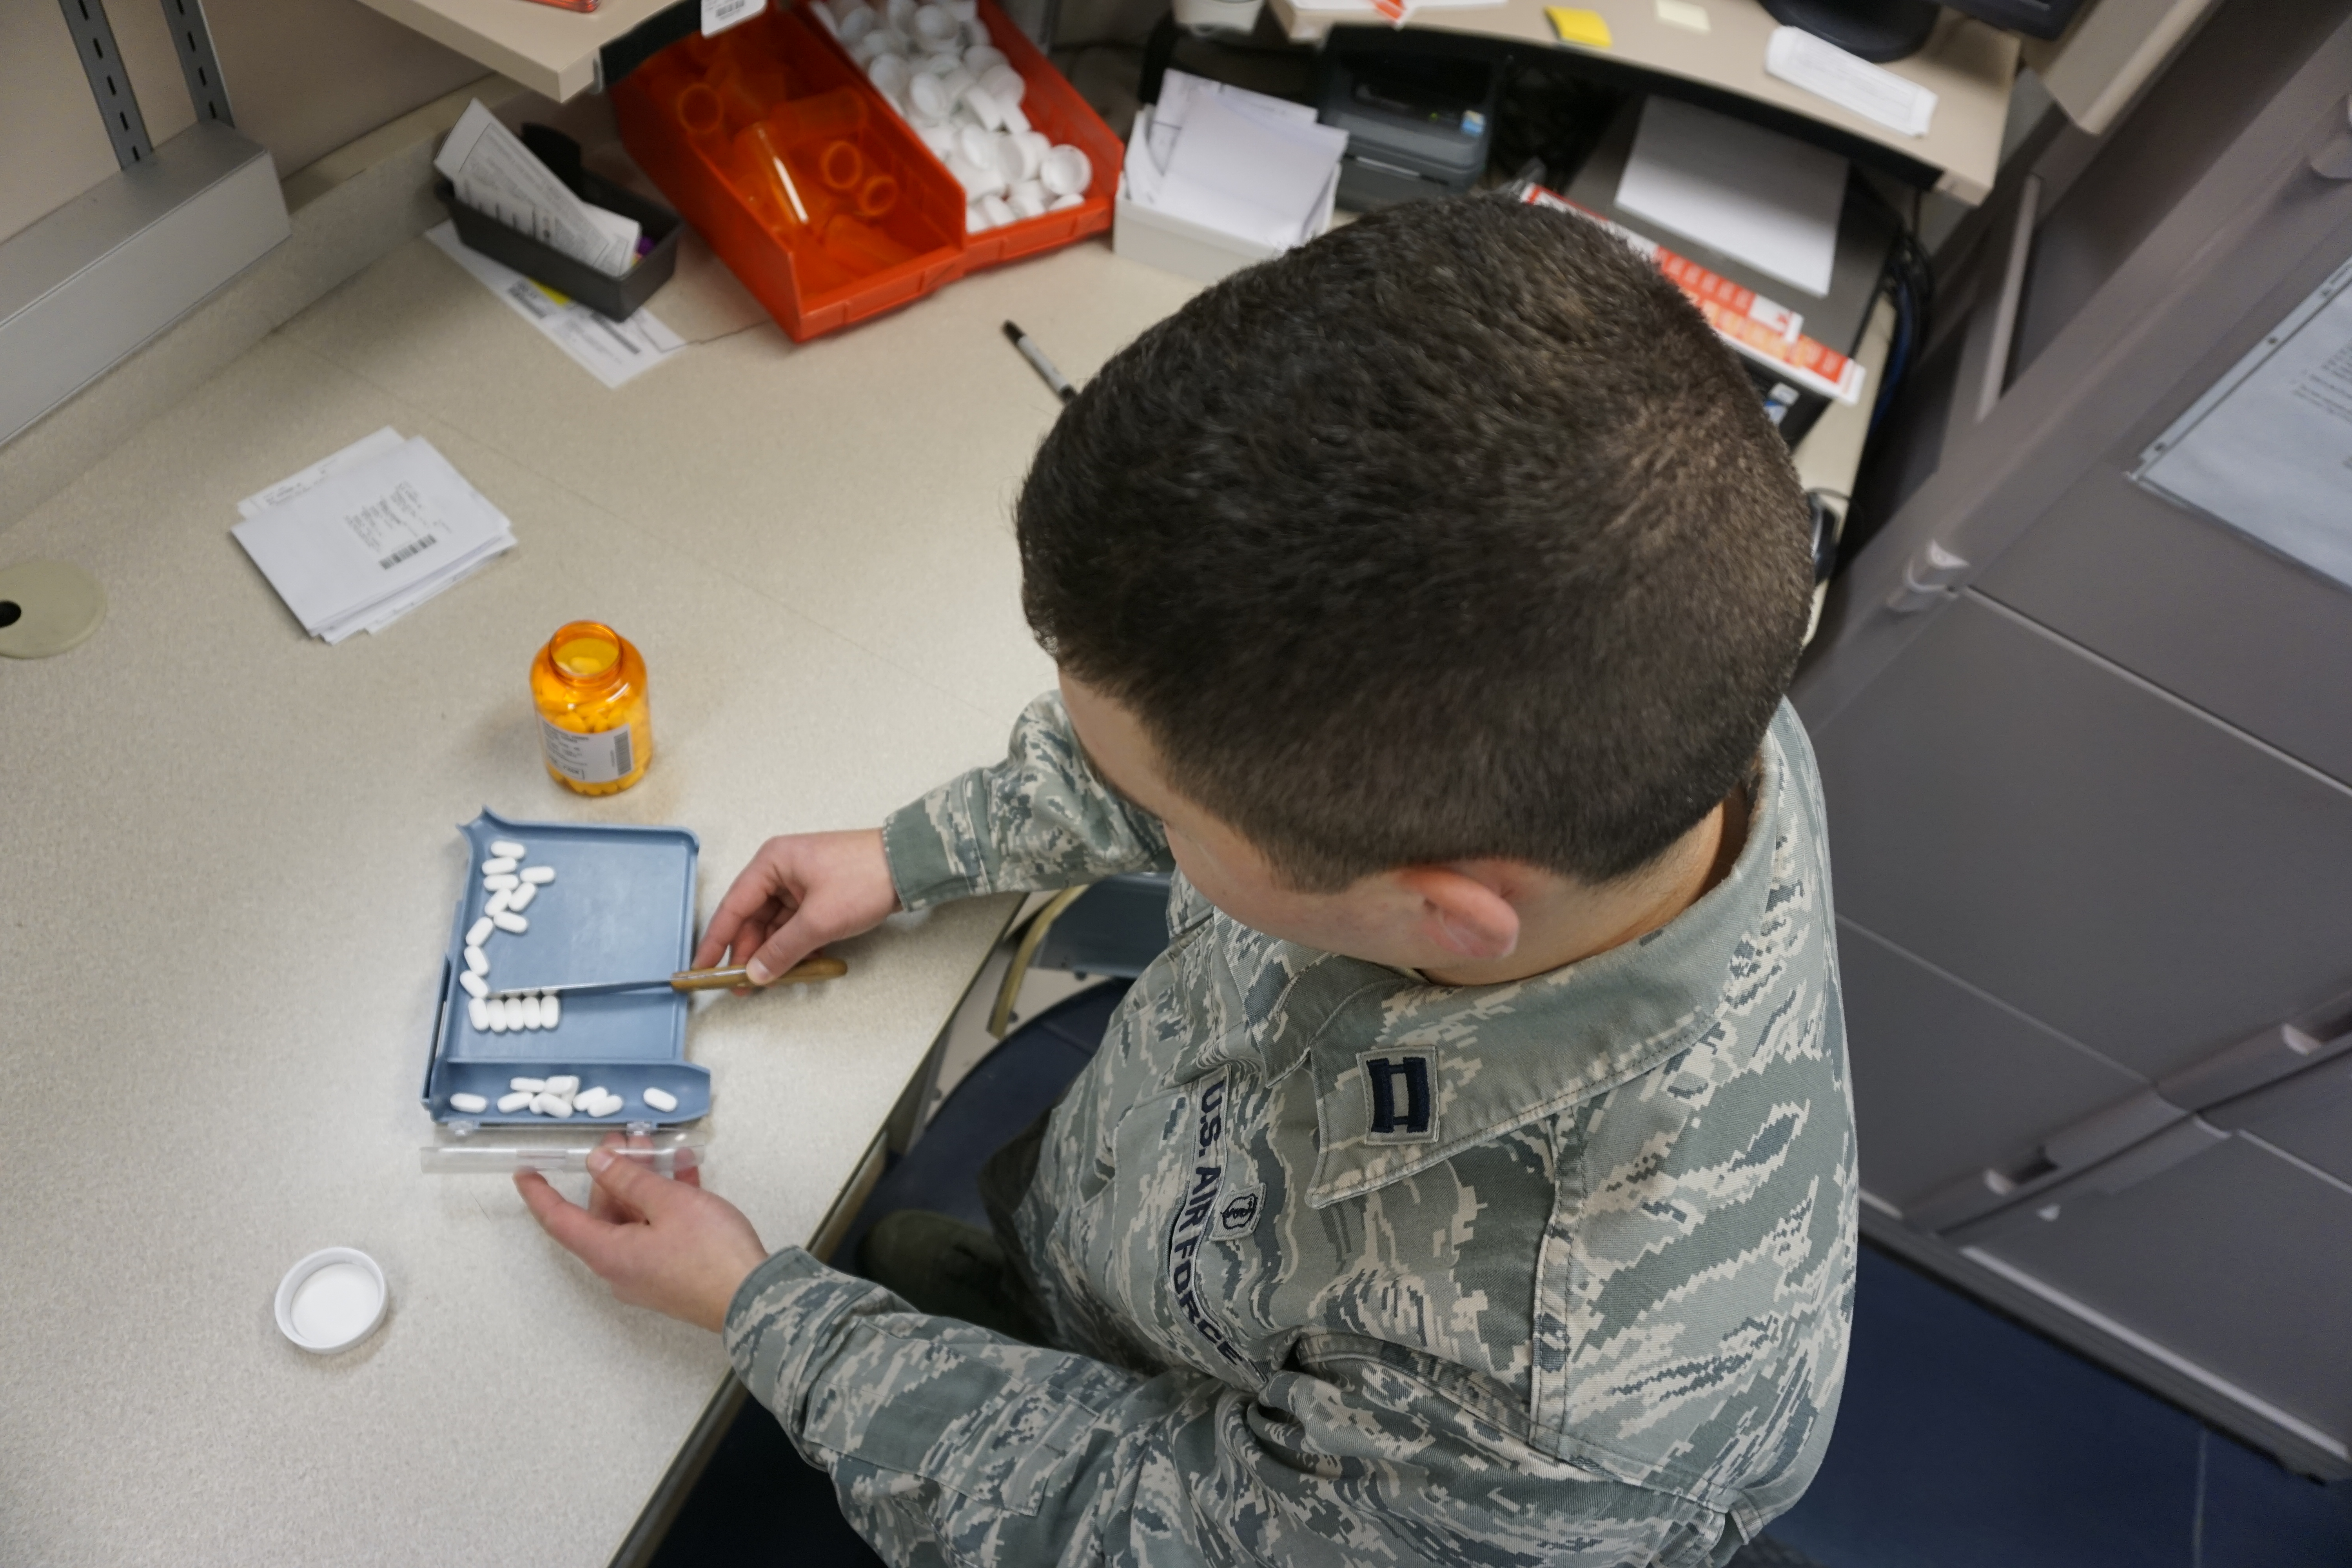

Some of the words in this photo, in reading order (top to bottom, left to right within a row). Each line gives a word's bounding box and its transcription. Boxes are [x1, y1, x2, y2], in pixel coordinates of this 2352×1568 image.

[1198, 1080, 1224, 1158] U.S.
[1179, 1166, 1221, 1232] AIR
[1174, 1235, 1243, 1366] FORCE
